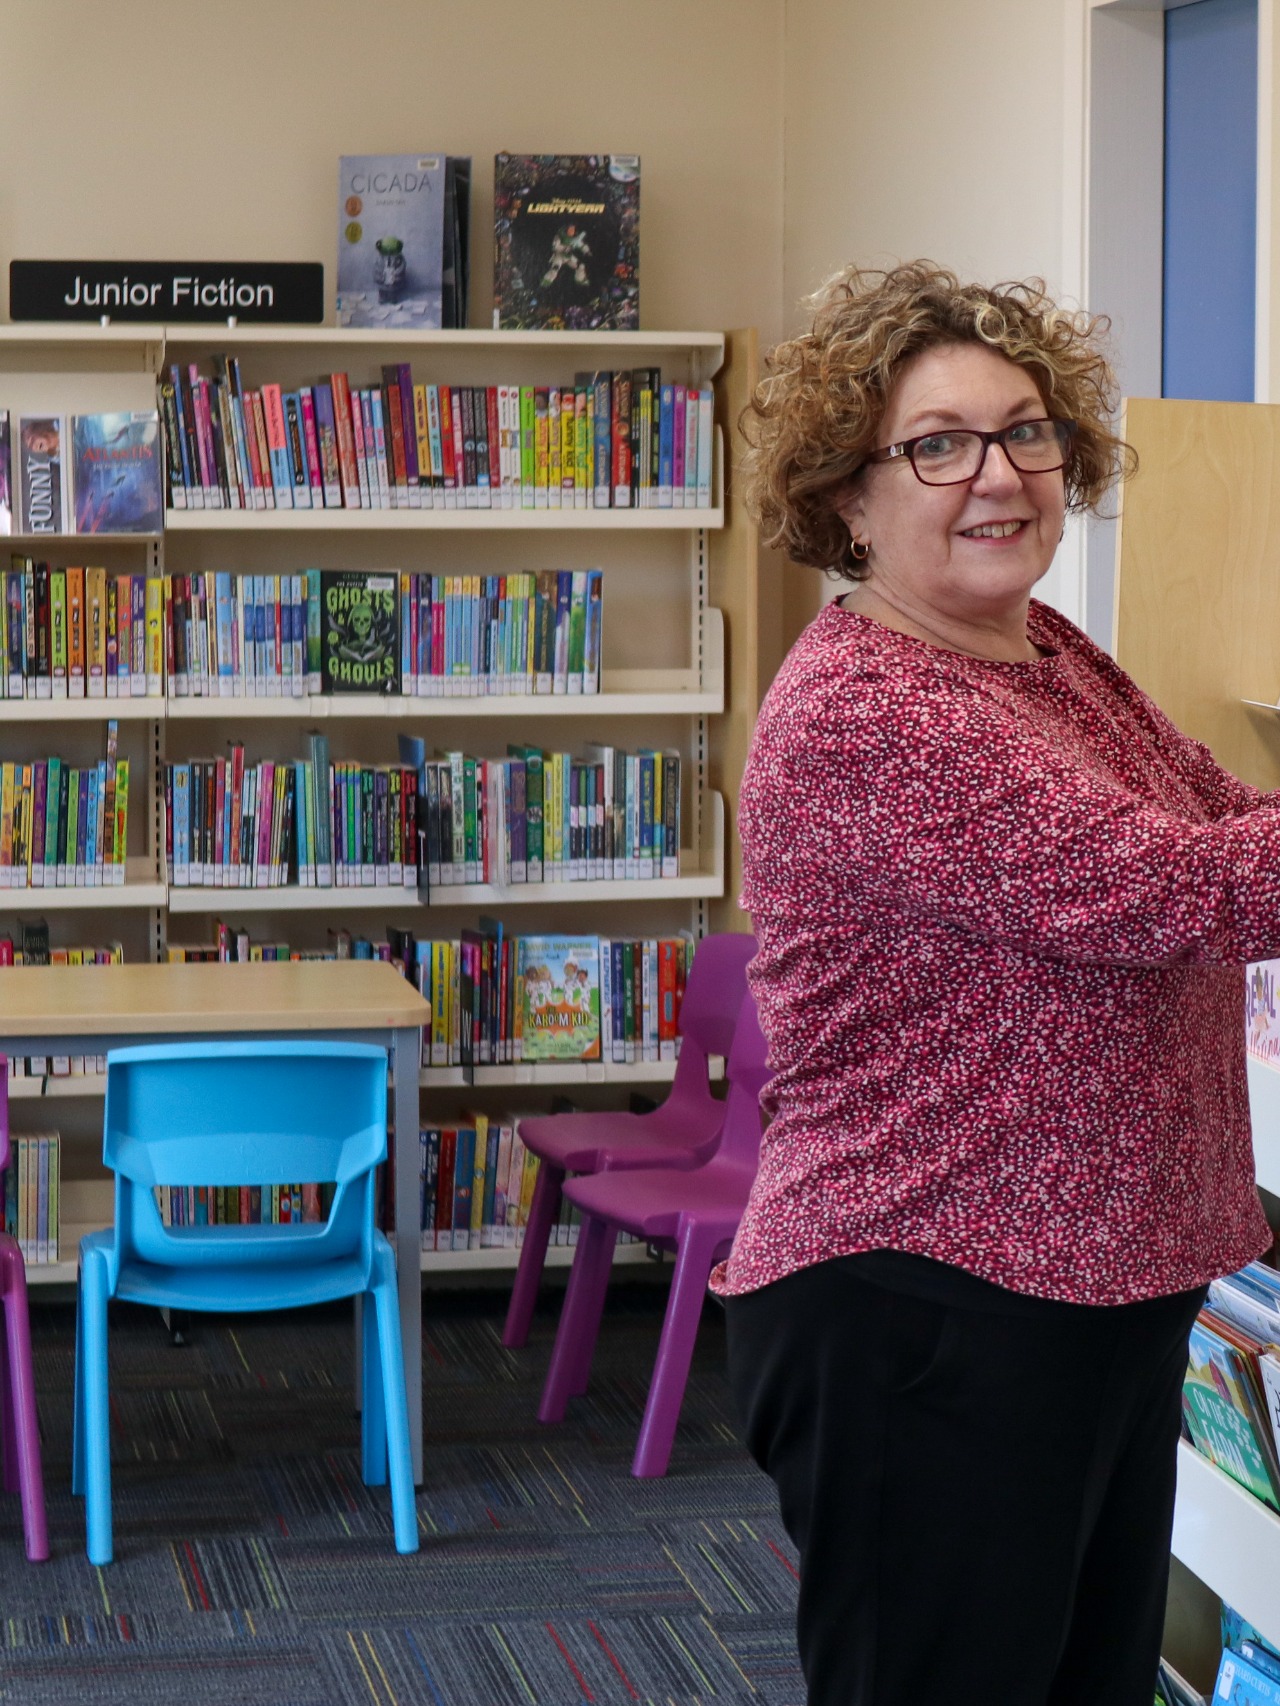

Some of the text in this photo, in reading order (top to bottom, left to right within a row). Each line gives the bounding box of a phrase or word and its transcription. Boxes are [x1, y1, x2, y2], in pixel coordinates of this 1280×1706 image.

[350, 172, 433, 194] CICADA
[527, 203, 605, 214] LIGHTYEAR
[64, 278, 274, 306] Junior Fiction
[27, 456, 55, 534] FUNNY
[326, 587, 394, 617] GHOSTS
[328, 656, 394, 686] GHOULS
